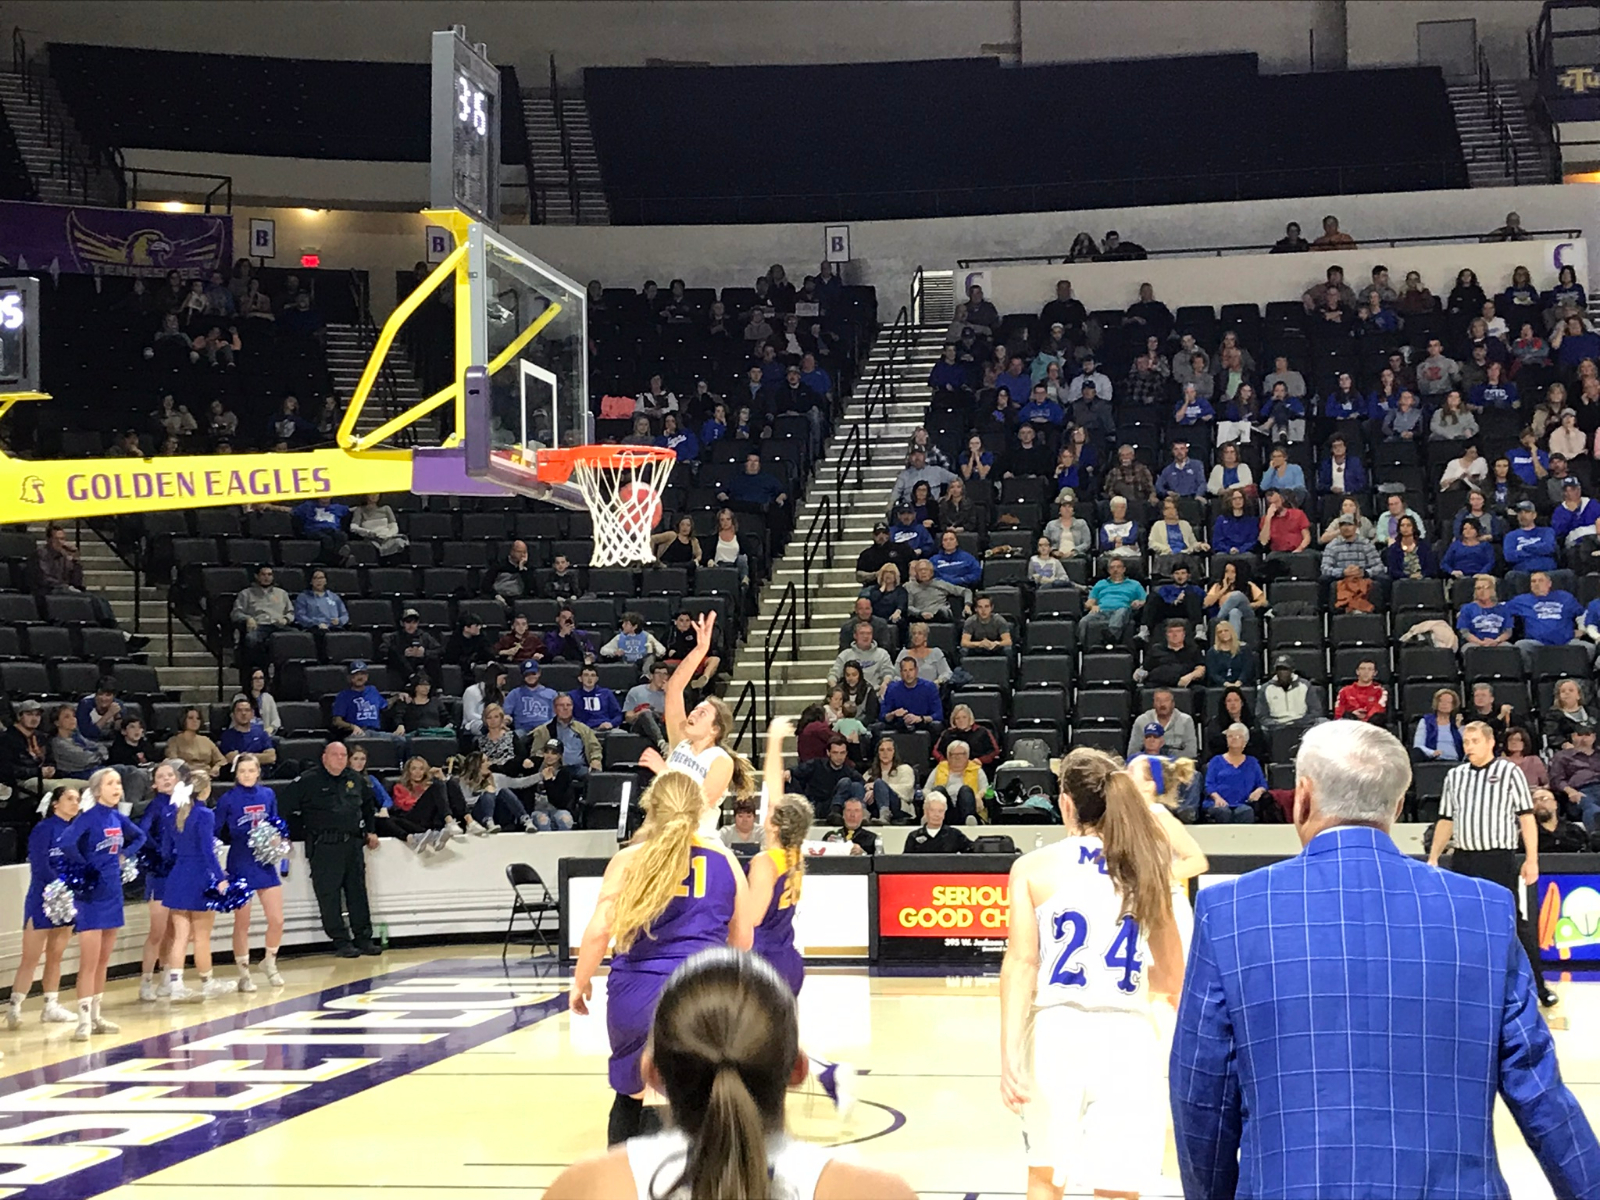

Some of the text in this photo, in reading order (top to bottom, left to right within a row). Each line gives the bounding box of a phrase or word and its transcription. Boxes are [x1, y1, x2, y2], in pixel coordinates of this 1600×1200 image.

[256, 229, 269, 247] B
[432, 236, 445, 252] B
[831, 236, 844, 252] B
[67, 467, 332, 502] GOLDEN EAGLES
[898, 907, 974, 928] GOOD
[1048, 910, 1143, 993] 24
